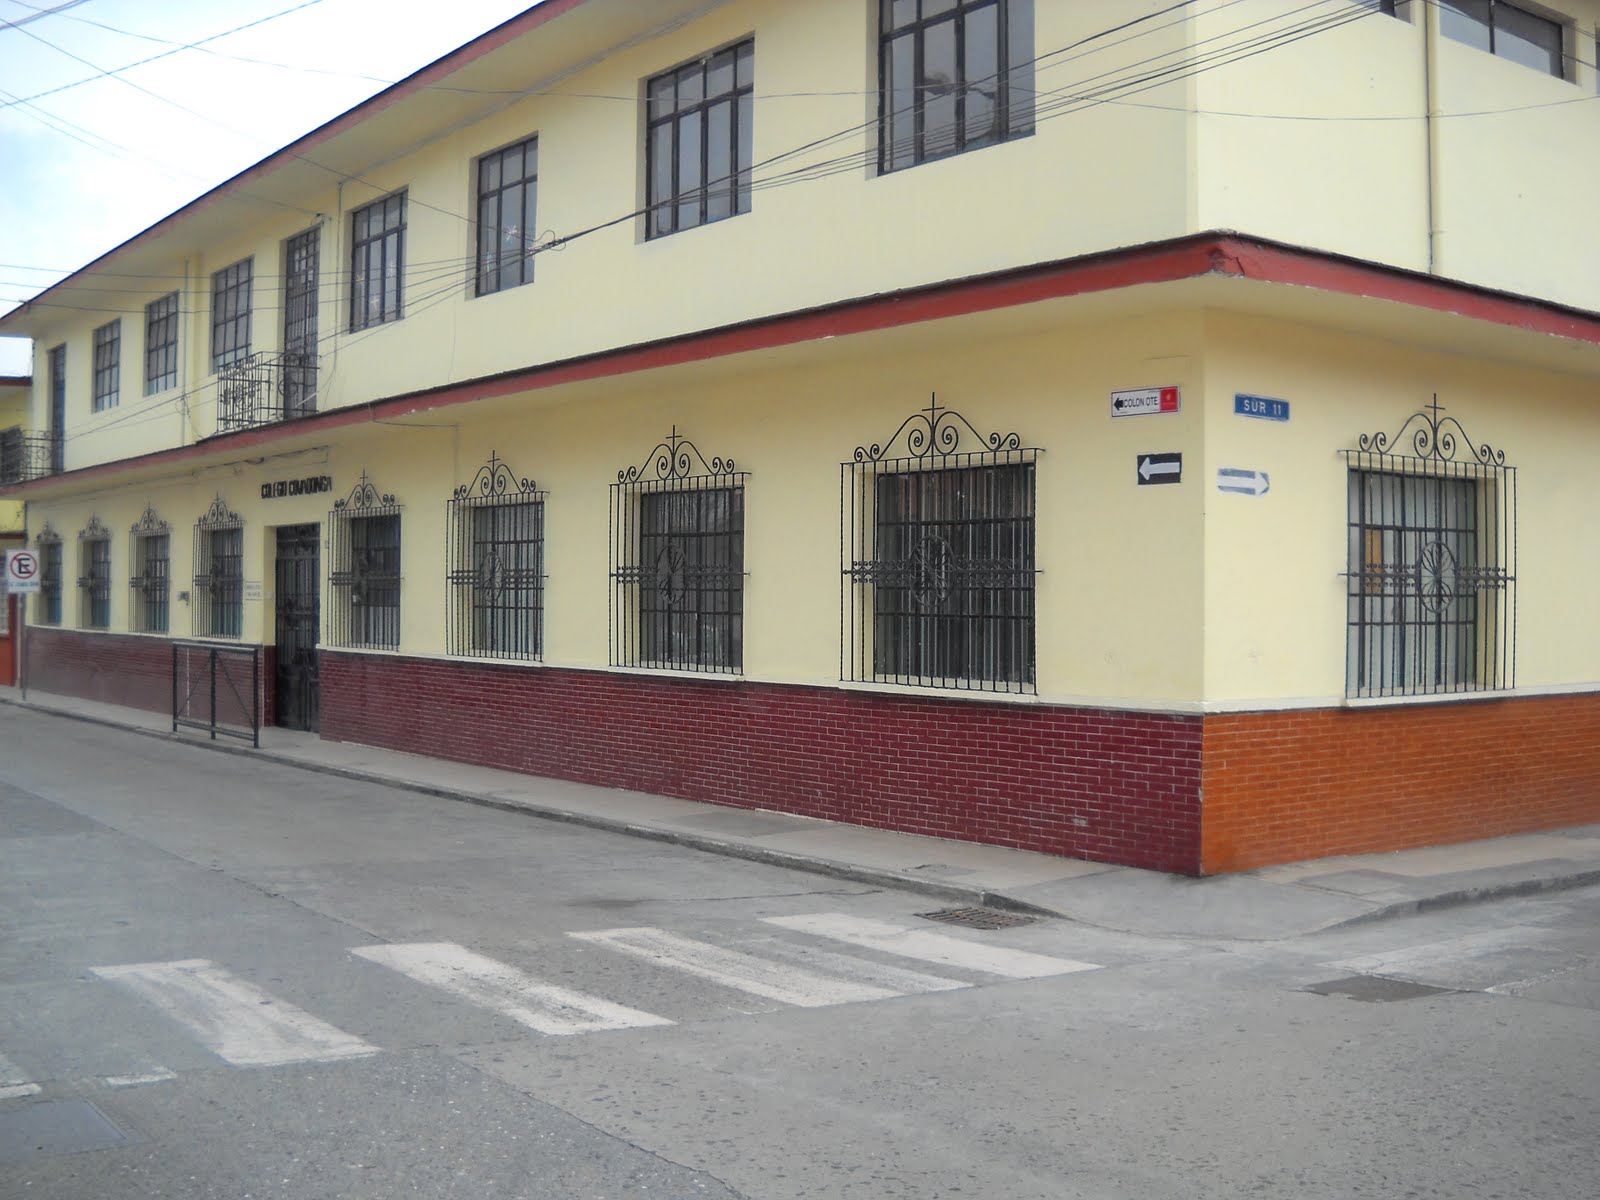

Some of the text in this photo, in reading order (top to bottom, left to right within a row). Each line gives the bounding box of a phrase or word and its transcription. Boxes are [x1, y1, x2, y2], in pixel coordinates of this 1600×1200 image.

[1124, 397, 1144, 408] COLON
[1244, 399, 1282, 415] SUR 11
[19, 558, 31, 574] E
